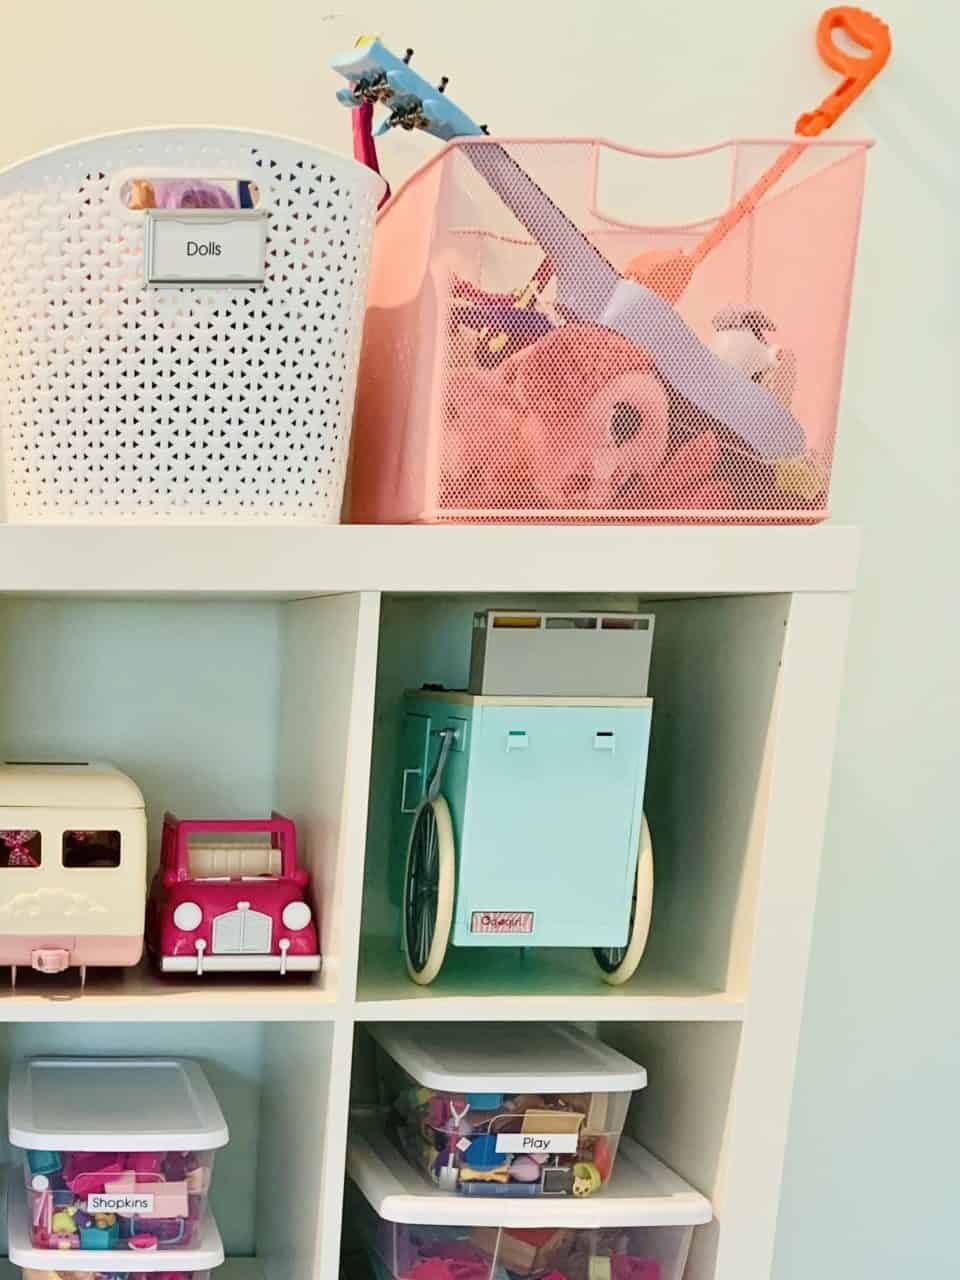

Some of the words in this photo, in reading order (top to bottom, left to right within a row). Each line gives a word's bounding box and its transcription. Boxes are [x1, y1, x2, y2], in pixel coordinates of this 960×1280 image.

[186, 241, 222, 256] Dolls
[522, 1137, 551, 1150] Play
[92, 1196, 148, 1209] Shopkins
